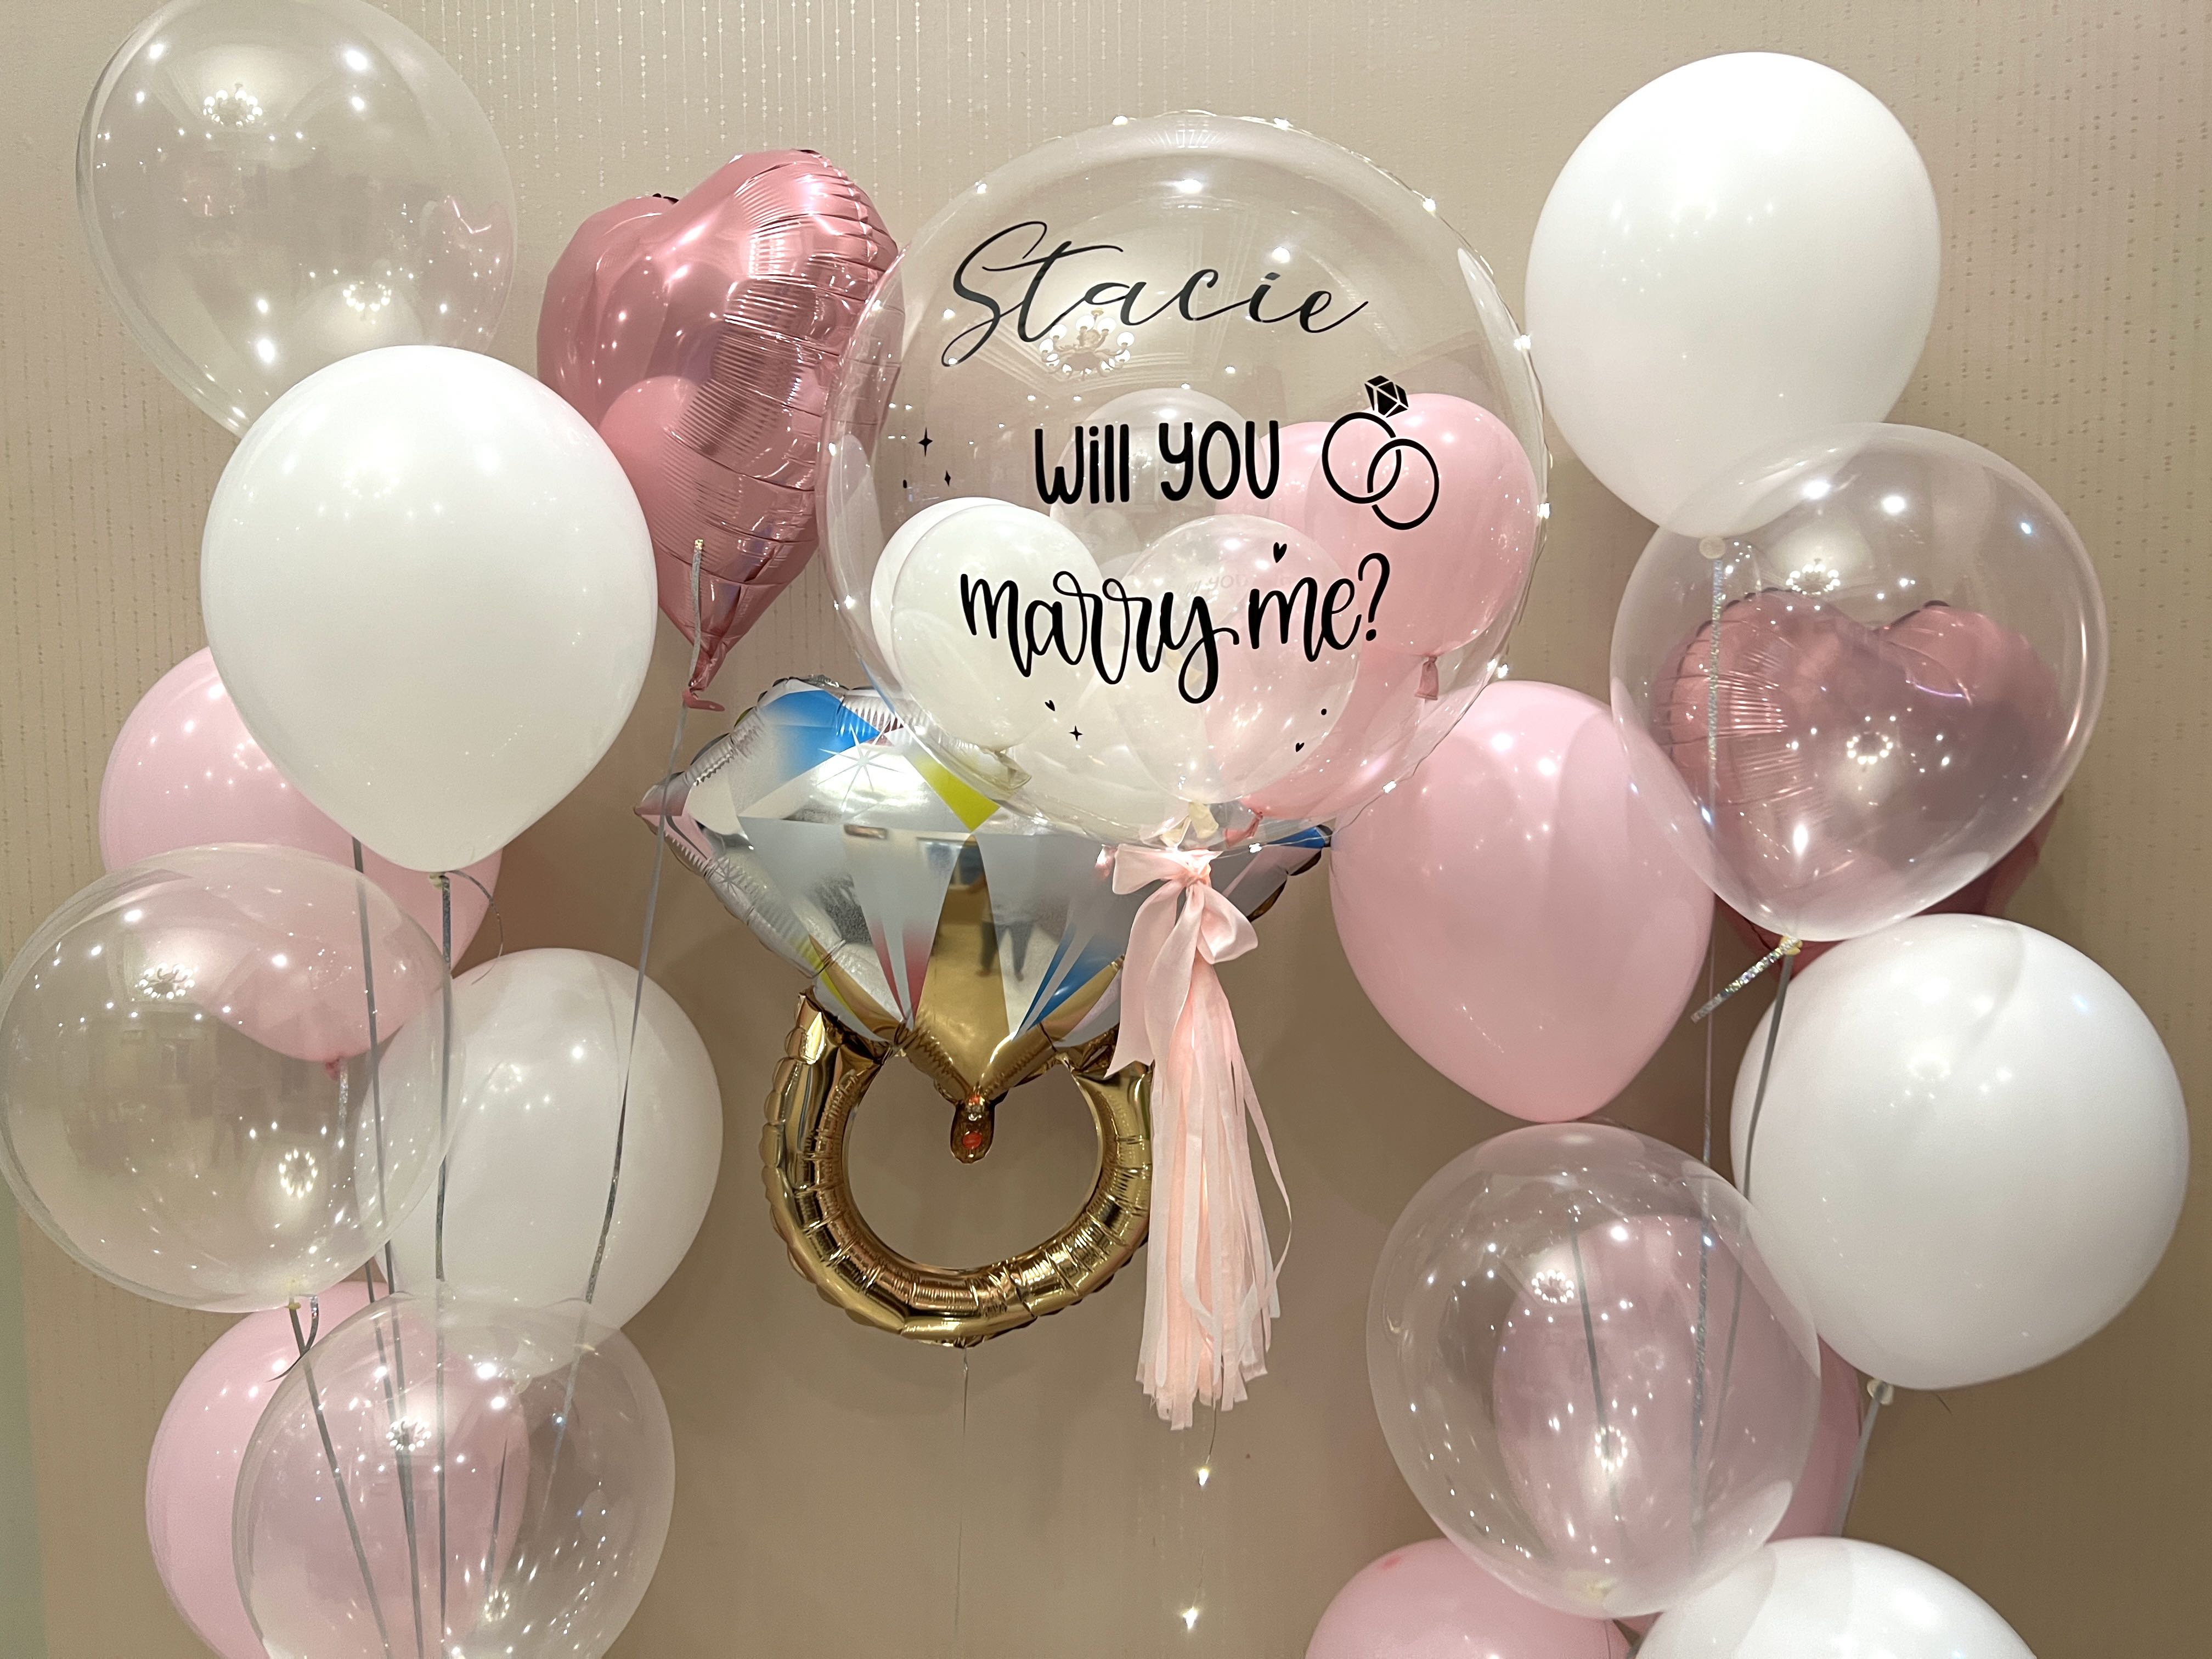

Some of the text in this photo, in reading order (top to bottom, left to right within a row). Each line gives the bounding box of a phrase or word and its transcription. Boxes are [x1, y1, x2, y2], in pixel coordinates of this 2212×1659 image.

[941, 221, 1369, 367] Stacie
[1034, 424, 1130, 505] Will
[960, 552, 1390, 704] marry me?
